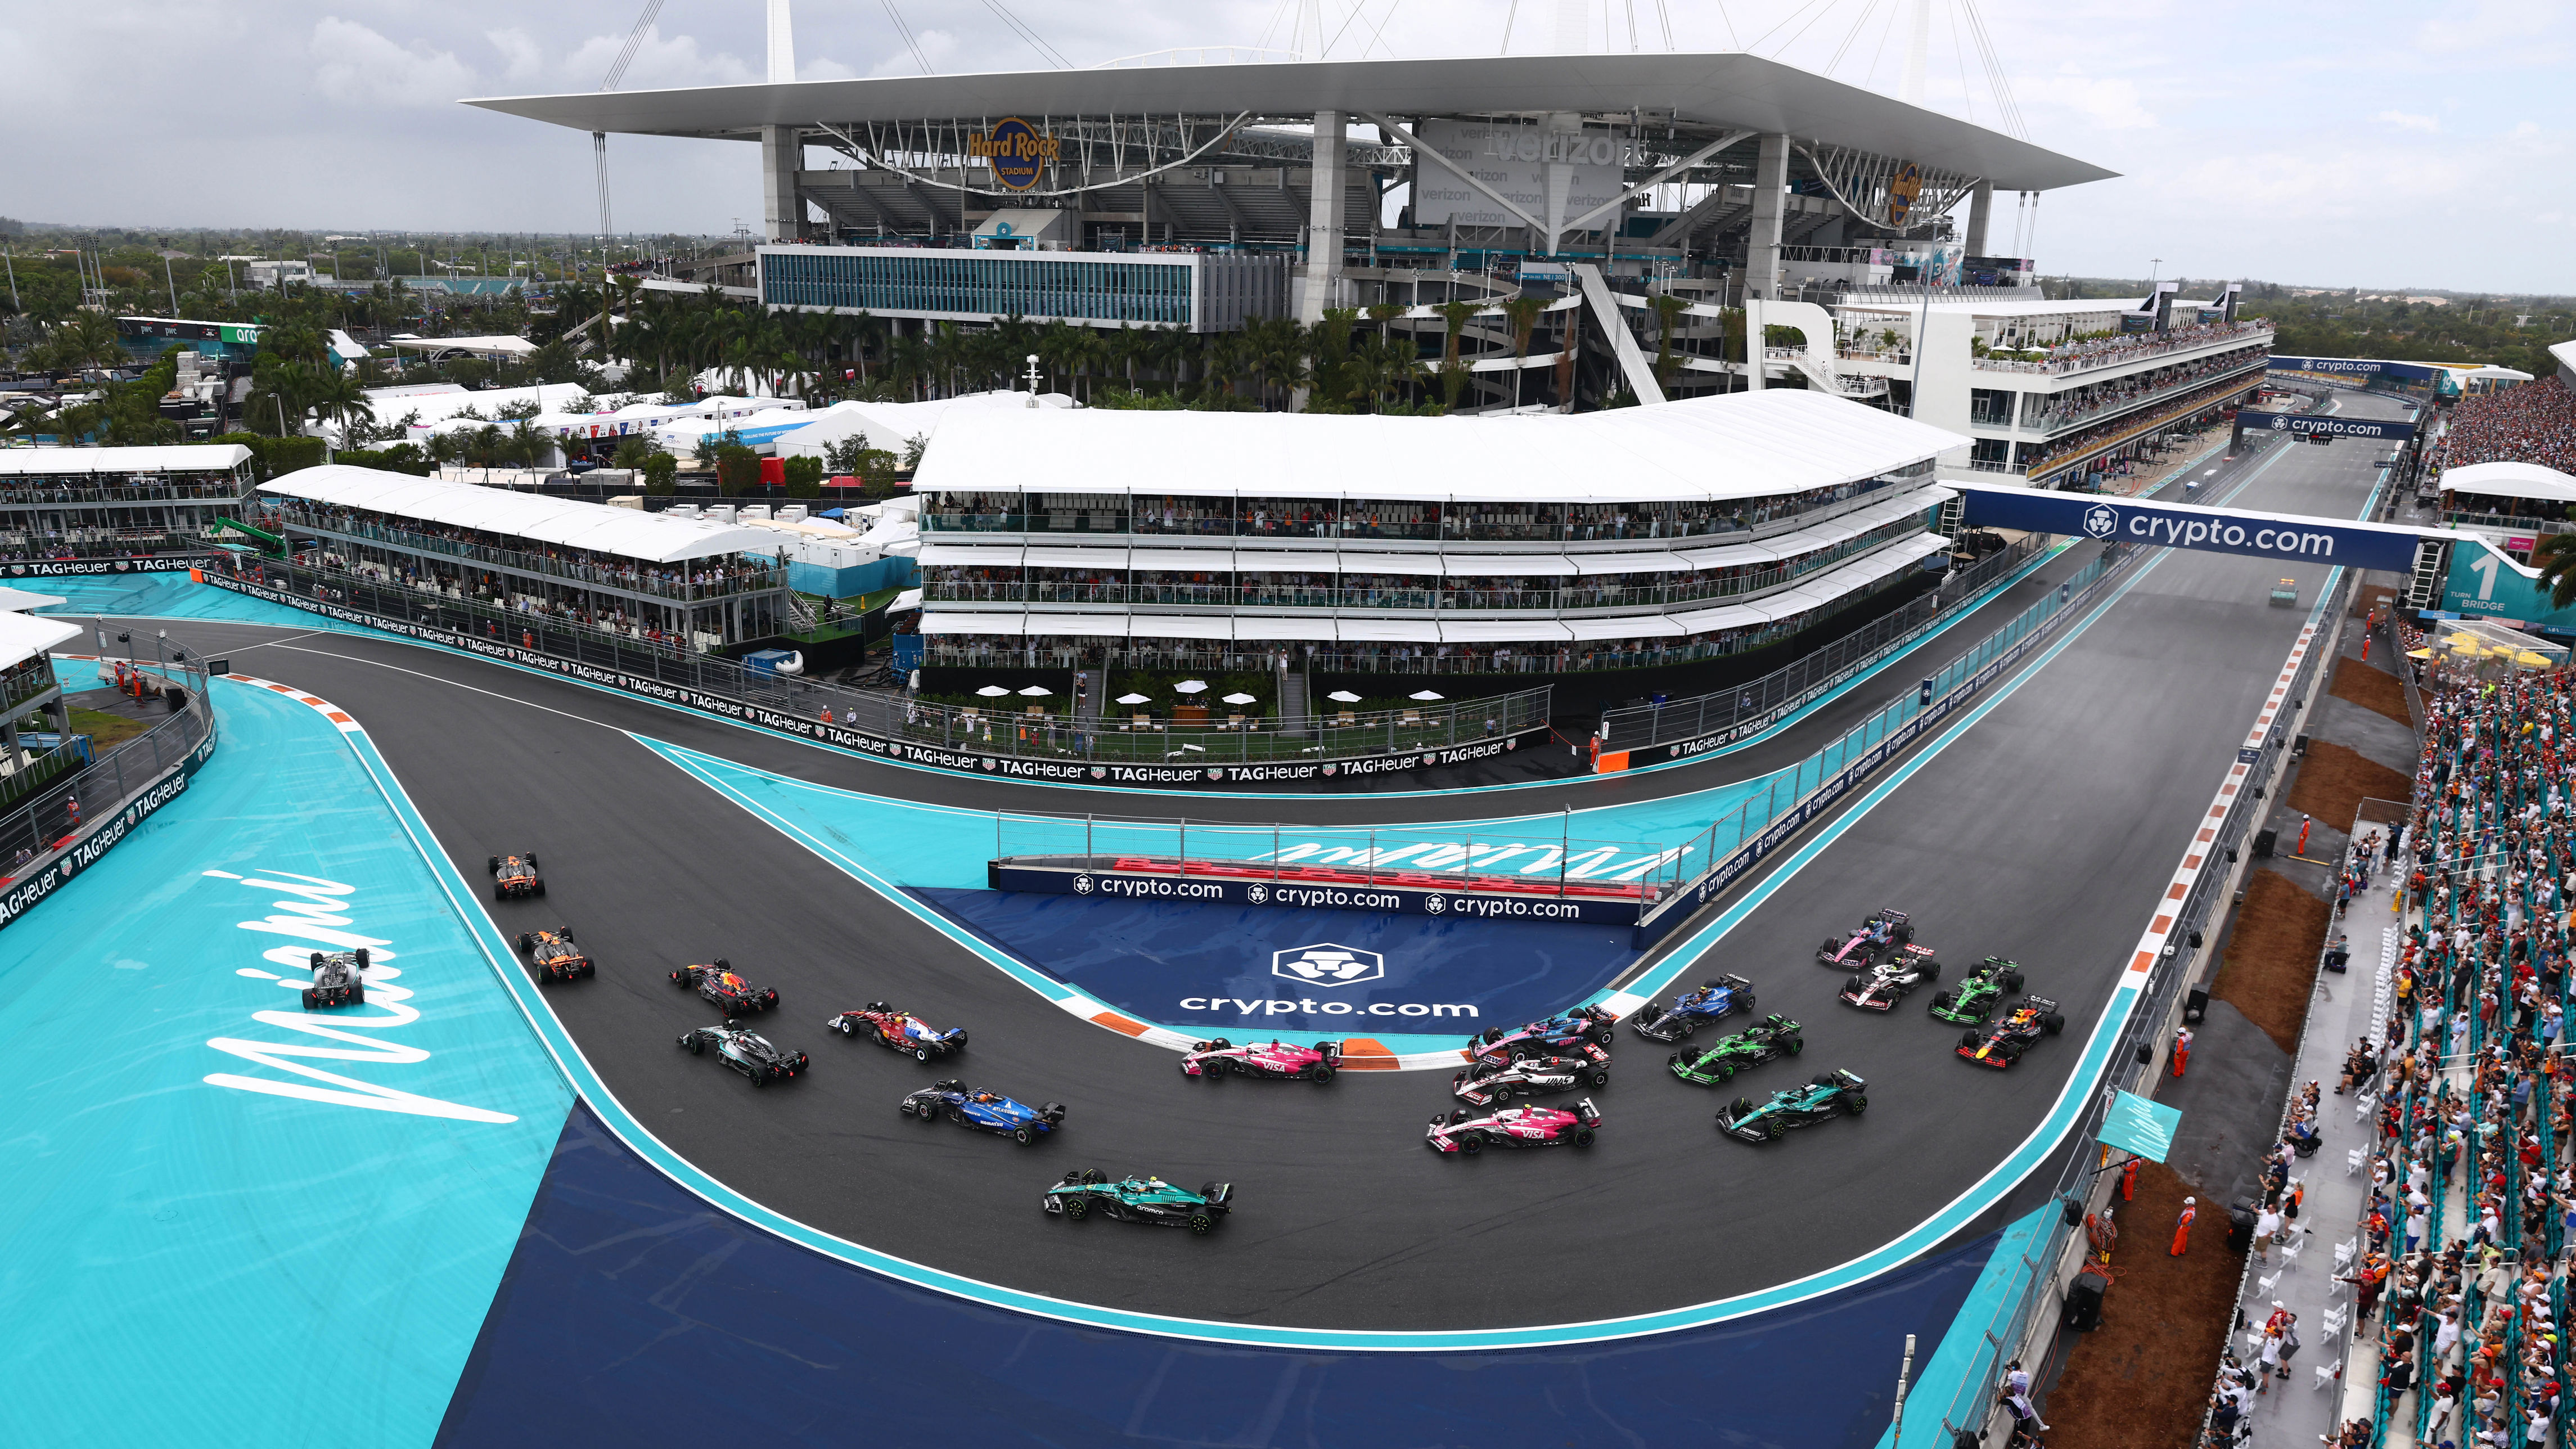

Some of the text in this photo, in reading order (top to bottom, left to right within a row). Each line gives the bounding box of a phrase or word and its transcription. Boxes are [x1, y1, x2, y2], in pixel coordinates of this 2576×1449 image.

[969, 132, 1060, 162] Hard Rock
[1496, 130, 1640, 166] verizon
[1421, 188, 1470, 201] verizon
[1456, 212, 1505, 223] verizon
[141, 326, 153, 335] pwc
[165, 327, 177, 336] pwc
[2316, 360, 2381, 372] crypto.com
[2442, 376, 2452, 391] 19
[2292, 420, 2381, 436] crypto.com
[2129, 516, 2333, 557] crypto.com
[29, 562, 111, 575] TAGHeuer
[133, 558, 211, 572] TAGHeuer
[209, 575, 240, 591] TAGHeuer
[2470, 552, 2500, 600] 1
[247, 585, 278, 601] TAGHeuer
[287, 595, 318, 612] TAGHeuer
[2461, 600, 2505, 611] BRIDGE
[327, 606, 363, 623] TAGHeuer
[372, 616, 408, 634] TAGHeuer
[417, 627, 456, 645] TAGHeuer
[466, 638, 506, 657] TAGHeuer
[2003, 648, 2020, 666] crypto.com
[516, 650, 559, 670] TAGHeuer
[1860, 653, 1879, 671] TAGHeuer
[571, 663, 616, 685] TAGHeuer
[1834, 667, 1856, 686] TAGHeuer
[1979, 666, 1997, 685] crypto.com
[629, 678, 677, 699] TAGHeuer
[1807, 681, 1830, 701] TAGHeuer
[1953, 683, 1973, 704] crypto.com
[691, 693, 742, 716] TAGHeuer
[1777, 698, 1802, 719] TAGHeuer
[757, 710, 812, 734] TAGHeuer
[1924, 703, 1946, 726] crypto.com
[1739, 716, 1770, 737] TAGHeuer
[827, 728, 886, 753] TAGHeuer
[1683, 734, 1728, 754] TAGHeuer
[1892, 725, 1916, 750] crypto.com
[904, 746, 978, 769] TAGHeuer
[1440, 742, 1503, 764] TAGHeuer
[1000, 759, 1086, 778] TAGHeuer
[1228, 766, 1317, 781] TAGHeuer
[1341, 755, 1419, 775] TAGHeuer
[1855, 750, 1882, 778] crypto.com
[1111, 767, 1202, 782] TAGHeuer
[136, 772, 185, 817] TAGHeuer
[1813, 778, 1844, 812] crypto.com
[127, 807, 136, 818] TAG
[1764, 812, 1800, 849] crypto.com
[74, 817, 125, 868] TAGHeuer
[60, 856, 71, 868] TAG
[1708, 850, 1749, 893] crypto.com
[0, 867, 57, 924] AGHeuer
[1101, 877, 1223, 902] crypto.com
[1276, 887, 1400, 912] crypto.com
[1453, 897, 1579, 922] crypto.com
[1728, 974, 1750, 983] ATLASSIAN
[1179, 994, 1480, 1019] crypto.com
[2026, 1028, 2042, 1038] ORACLE
[1262, 1061, 1286, 1072] VISA
[992, 1106, 1019, 1117] ATLASSIAN
[1520, 1130, 1544, 1139] VISA
[1137, 1205, 1164, 1216] aramco
